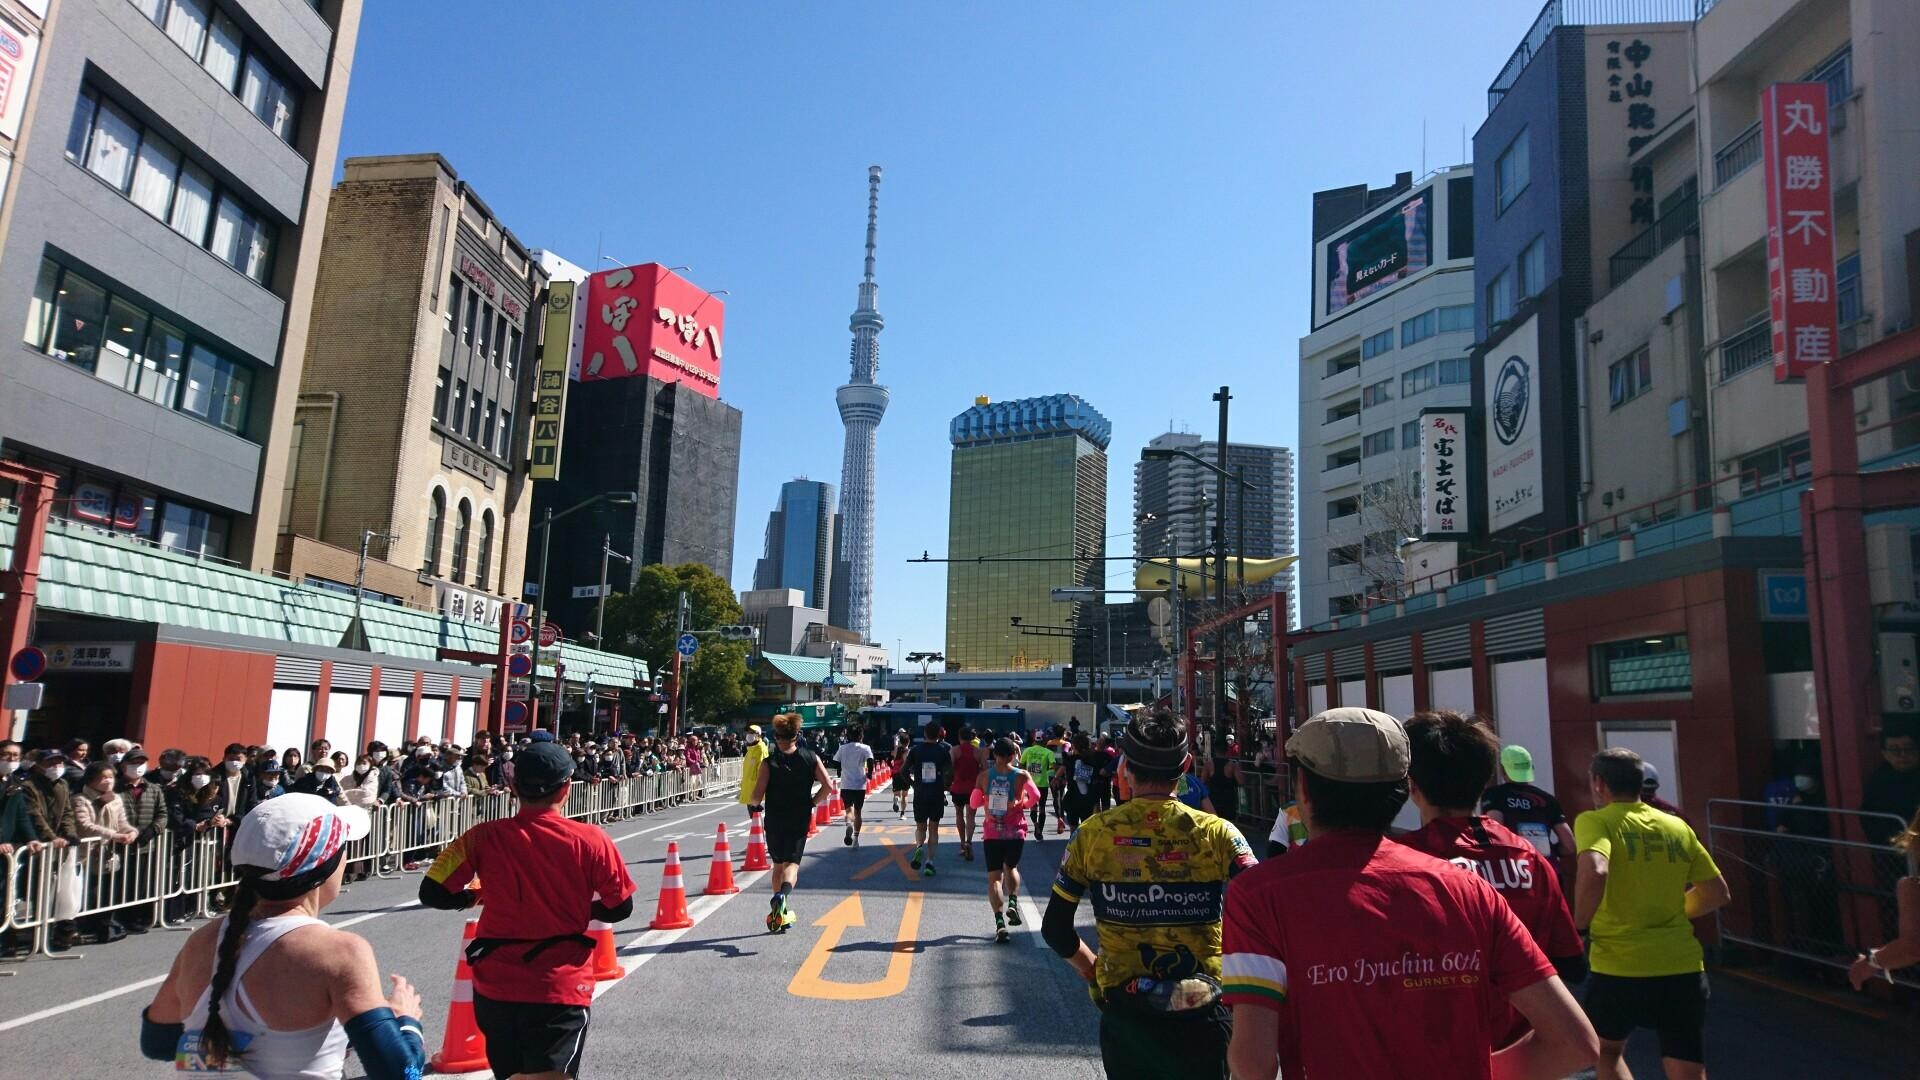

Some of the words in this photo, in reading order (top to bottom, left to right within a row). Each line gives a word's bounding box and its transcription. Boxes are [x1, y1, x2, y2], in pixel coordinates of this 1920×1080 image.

[1783, 99, 1832, 363] 丸勝不動産
[1355, 251, 1398, 282] 見えないカード
[585, 268, 639, 373] つぼ八
[658, 306, 722, 361] つぼ八
[537, 372, 562, 465] 神谷バー
[1434, 437, 1459, 515] 富士そば
[81, 489, 135, 518] SEIS
[73, 647, 112, 659] 浅草駅
[1507, 797, 1532, 810] SAB
[1158, 838, 1190, 848] SUUNTO
[1106, 905, 1211, 919] http://fun-run.tokyo
[1307, 964, 1348, 985] Ero
[1353, 951, 1434, 987] Jyuchin
[1441, 950, 1481, 972] 60th
[1403, 975, 1457, 989] GURNEY
